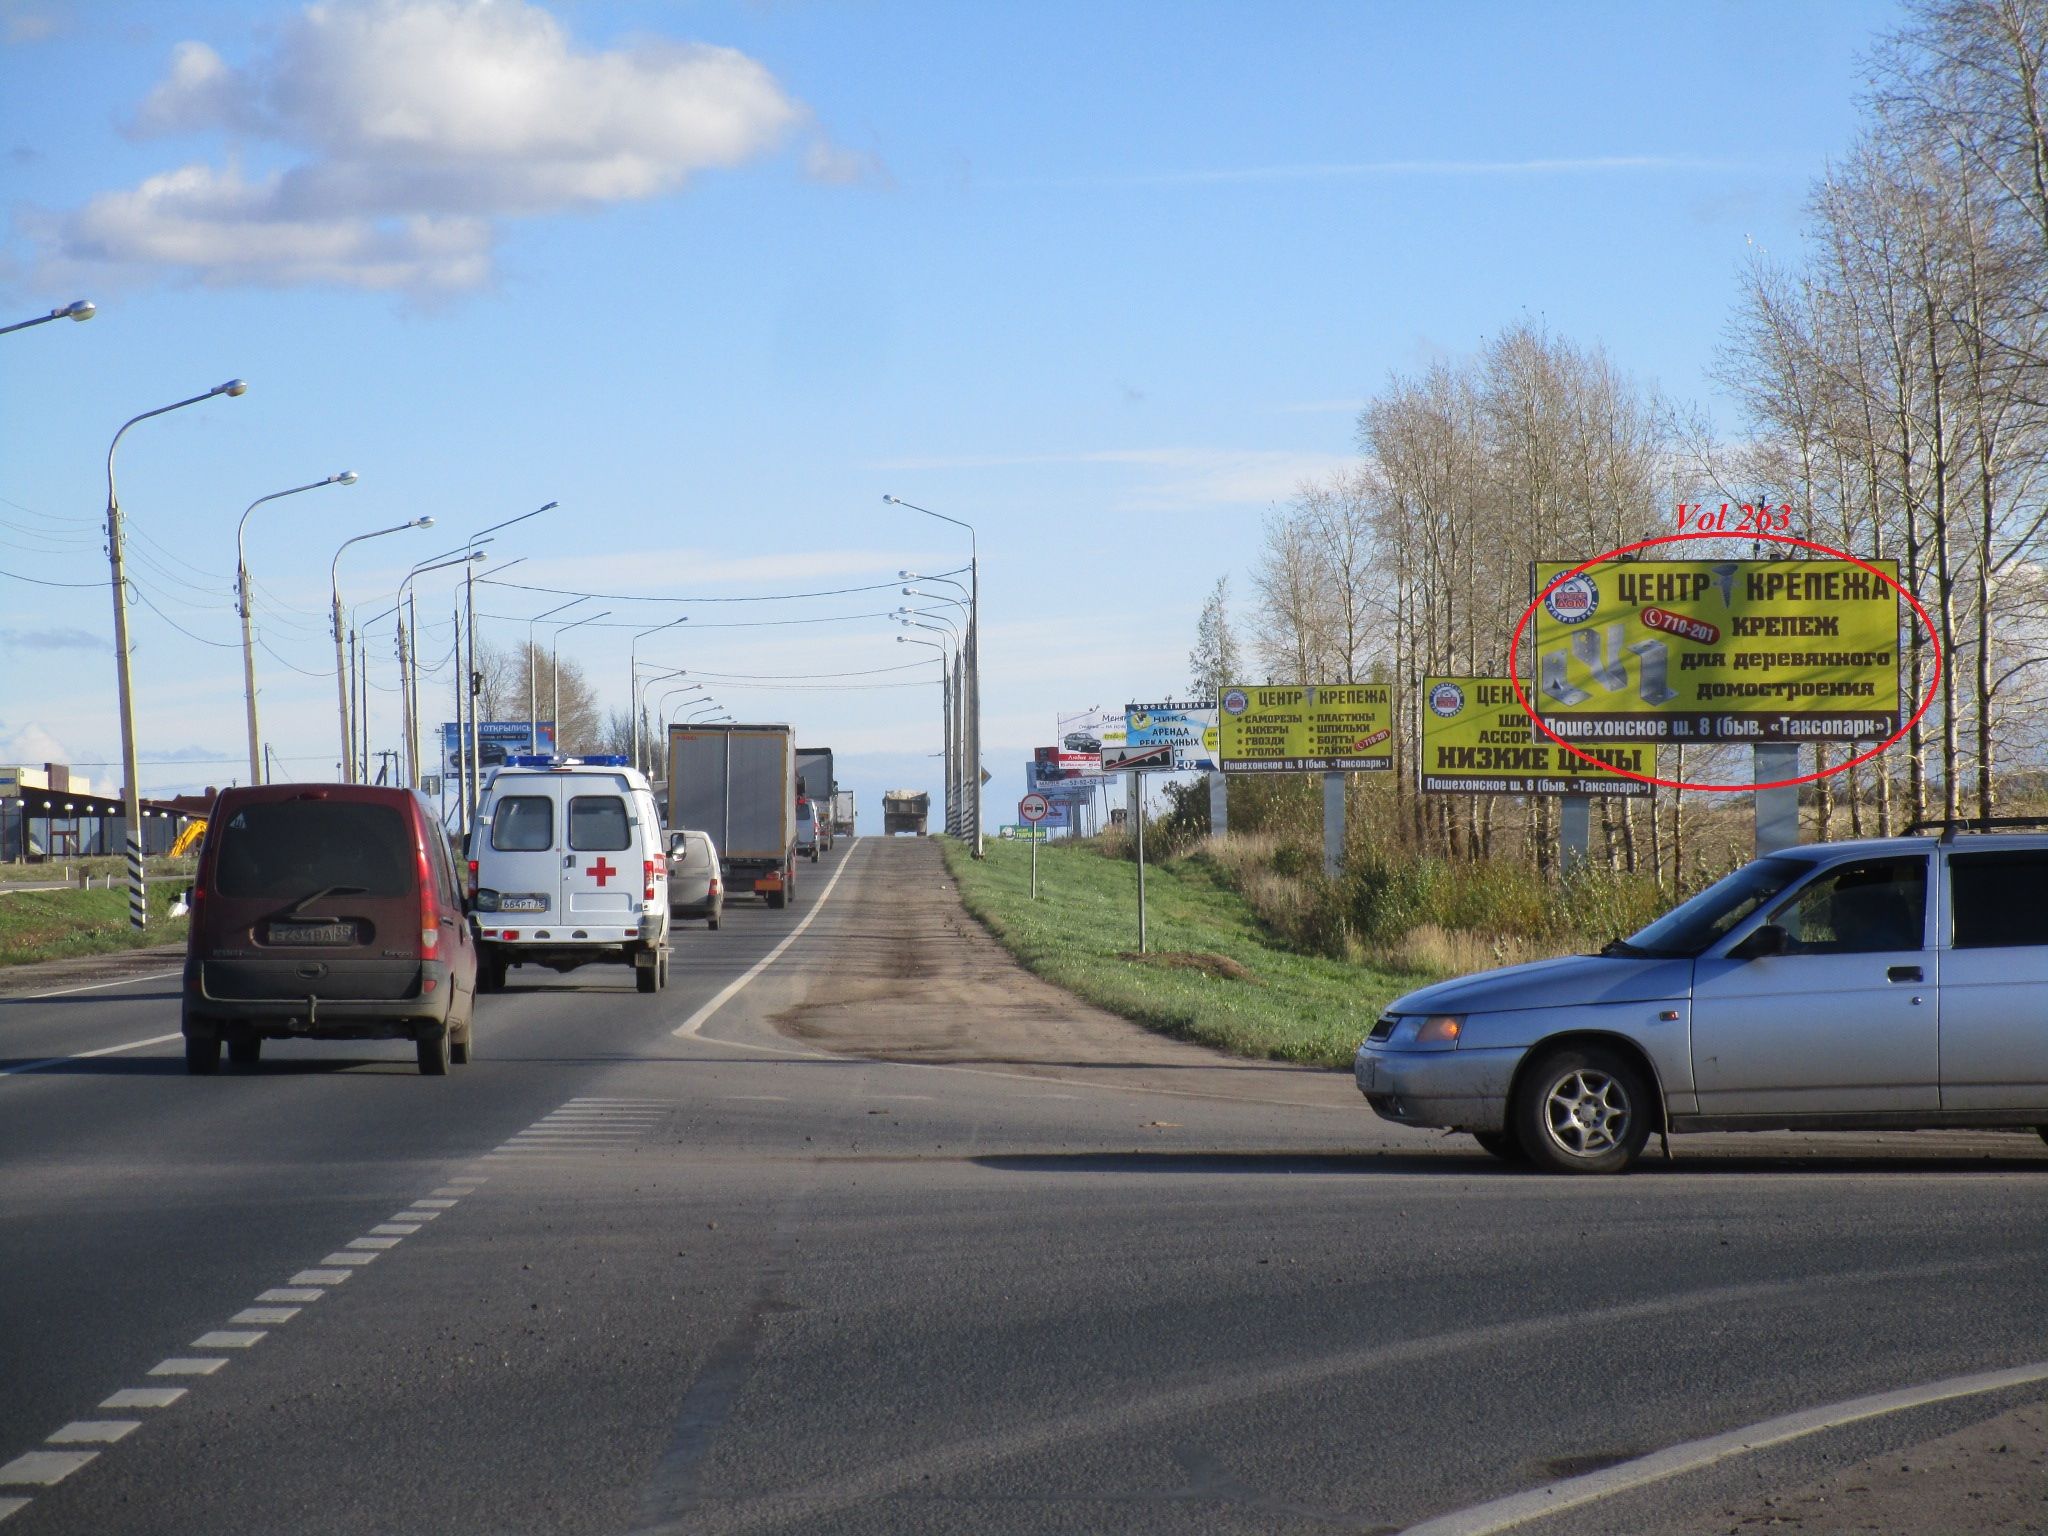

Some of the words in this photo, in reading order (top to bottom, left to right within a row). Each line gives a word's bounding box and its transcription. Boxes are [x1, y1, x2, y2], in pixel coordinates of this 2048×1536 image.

[1618, 573, 1710, 606] ЦЕНТР
[1747, 572, 1891, 601] КРЕПЕЖА
[1663, 615, 1714, 642] 710-201
[1732, 616, 1840, 637] КРЕПЕЖ
[1681, 653, 1726, 671] для
[1733, 653, 1891, 671] деревянного
[1697, 682, 1875, 701] домостроения
[1258, 691, 1303, 707] ЦЕНТР
[1319, 689, 1388, 705] КРЕПЕЖА
[1137, 703, 1204, 711] ЭФФЕКТИВНАЯ
[1244, 714, 1303, 724] САМОРЕЗЫ
[1316, 713, 1376, 722] ПЛАСТИНЫ
[483, 724, 532, 732] ОТКРЫЛИСЬ
[1245, 725, 1289, 735] АНКЕРЫ
[1316, 724, 1370, 733] ШПИЛЬКИ
[1544, 718, 1668, 736] Пошехонское
[1673, 722, 1694, 736] ш.
[1700, 718, 1710, 735] 8
[1716, 718, 1764, 737] (быв.
[1770, 717, 1892, 737] «Таксопарк»)
[1152, 728, 1190, 737] АРЕНДА
[1140, 738, 1200, 747] РЕКЛАМНЫХ
[1245, 736, 1285, 746] ГВОЗДИ
[1316, 735, 1355, 745] БОЛТЫ
[1245, 747, 1286, 757] УГОЛКИ
[1317, 745, 1353, 755] ГАЙКИ
[1224, 761, 1283, 770] Пошехонское
[1285, 762, 1296, 770] ш.
[1298, 760, 1304, 769] 8
[1437, 746, 1549, 770] НИЗКИЕ
[1558, 748, 1642, 774] ЦЕНЫ
[1426, 777, 1507, 791] Пошехонское
[1510, 781, 1524, 791] ш.
[1527, 780, 1535, 791] 8
[1537, 780, 1568, 793] (быв.
[1572, 779, 1651, 794] «Таксопарк»)
